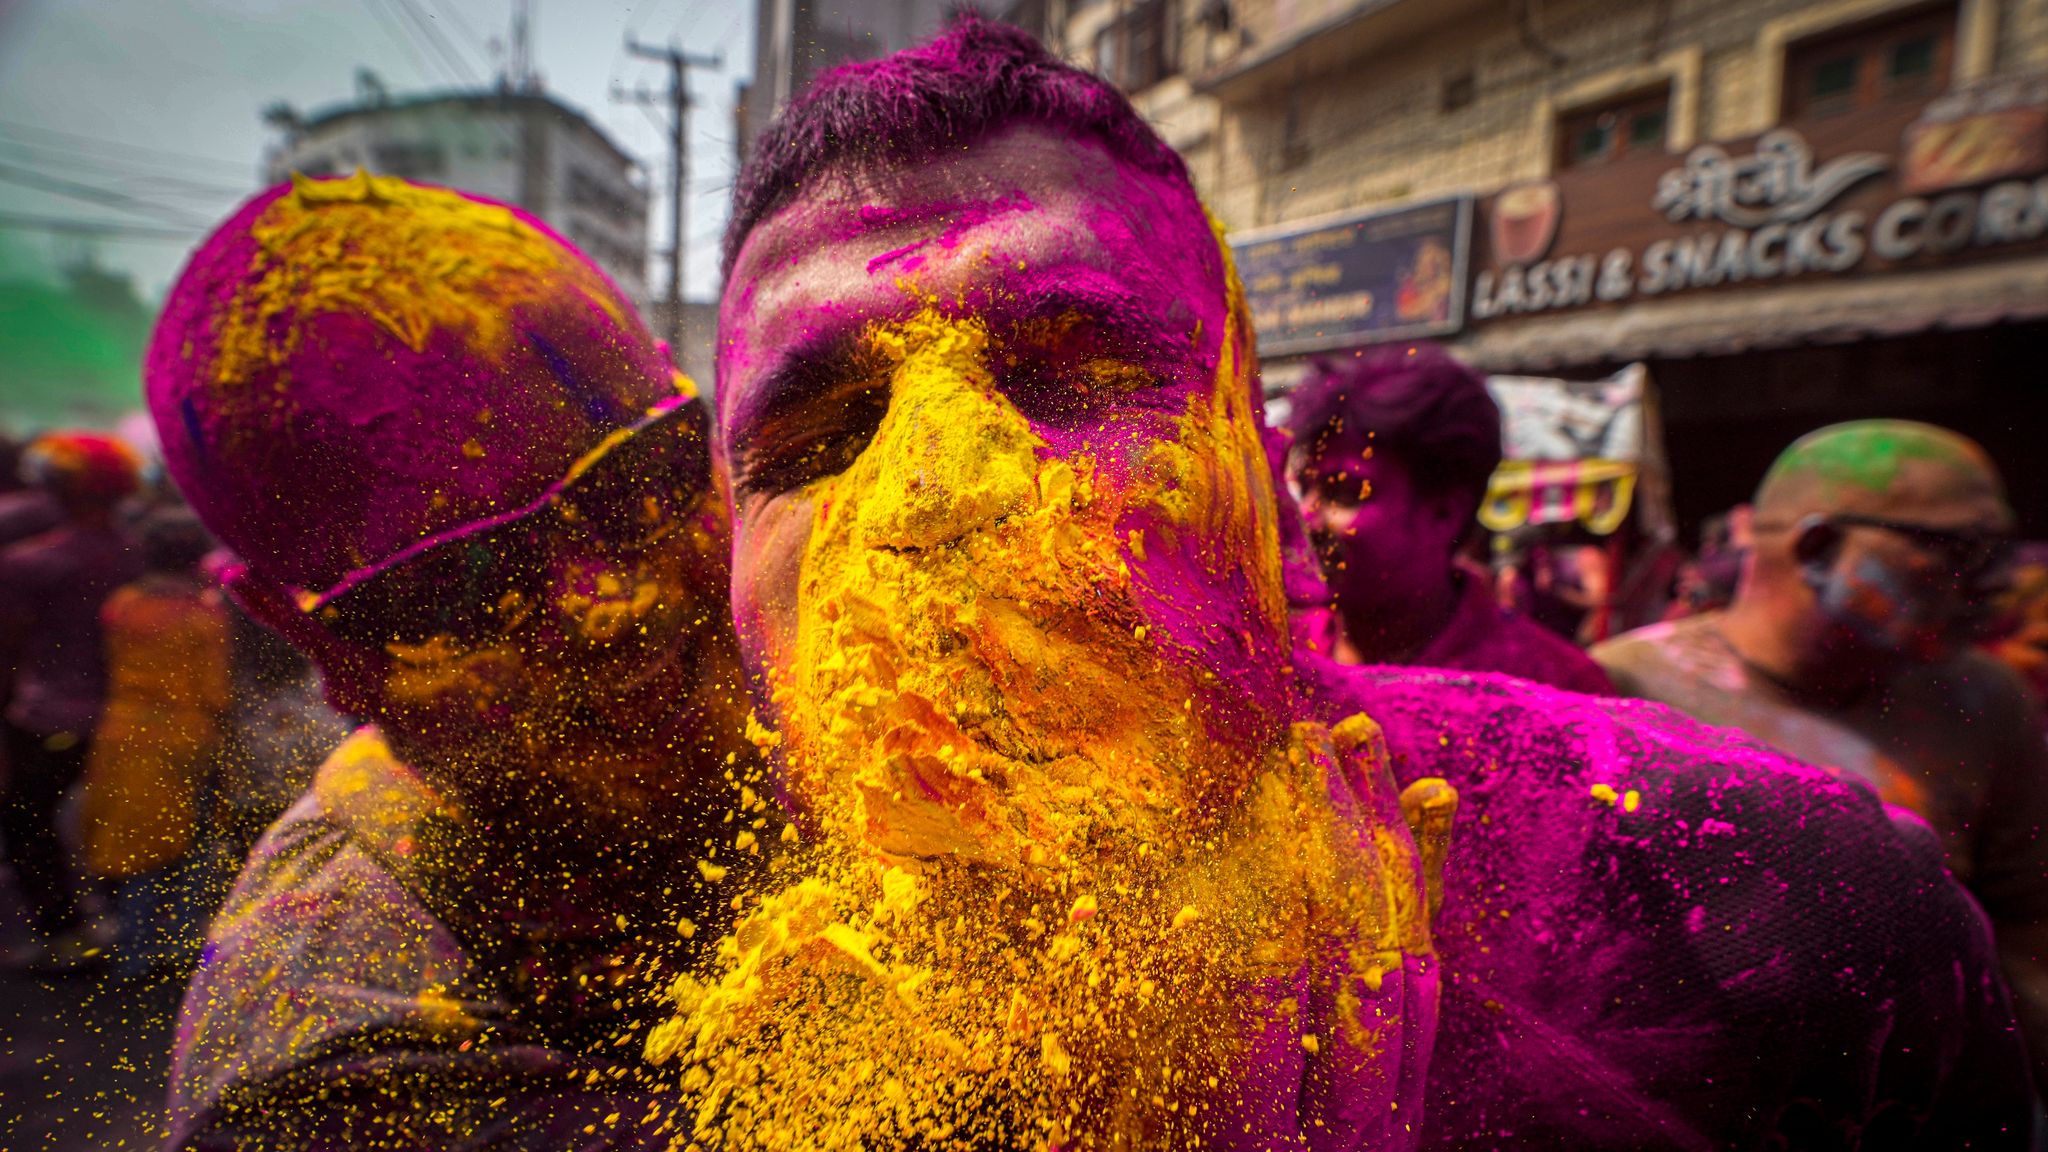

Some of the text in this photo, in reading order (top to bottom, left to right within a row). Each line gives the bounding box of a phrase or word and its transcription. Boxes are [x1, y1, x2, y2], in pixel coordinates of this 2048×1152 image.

[1472, 253, 1597, 319] LASSI
[1596, 247, 1634, 300] &
[1639, 209, 1866, 294] SNACKS
